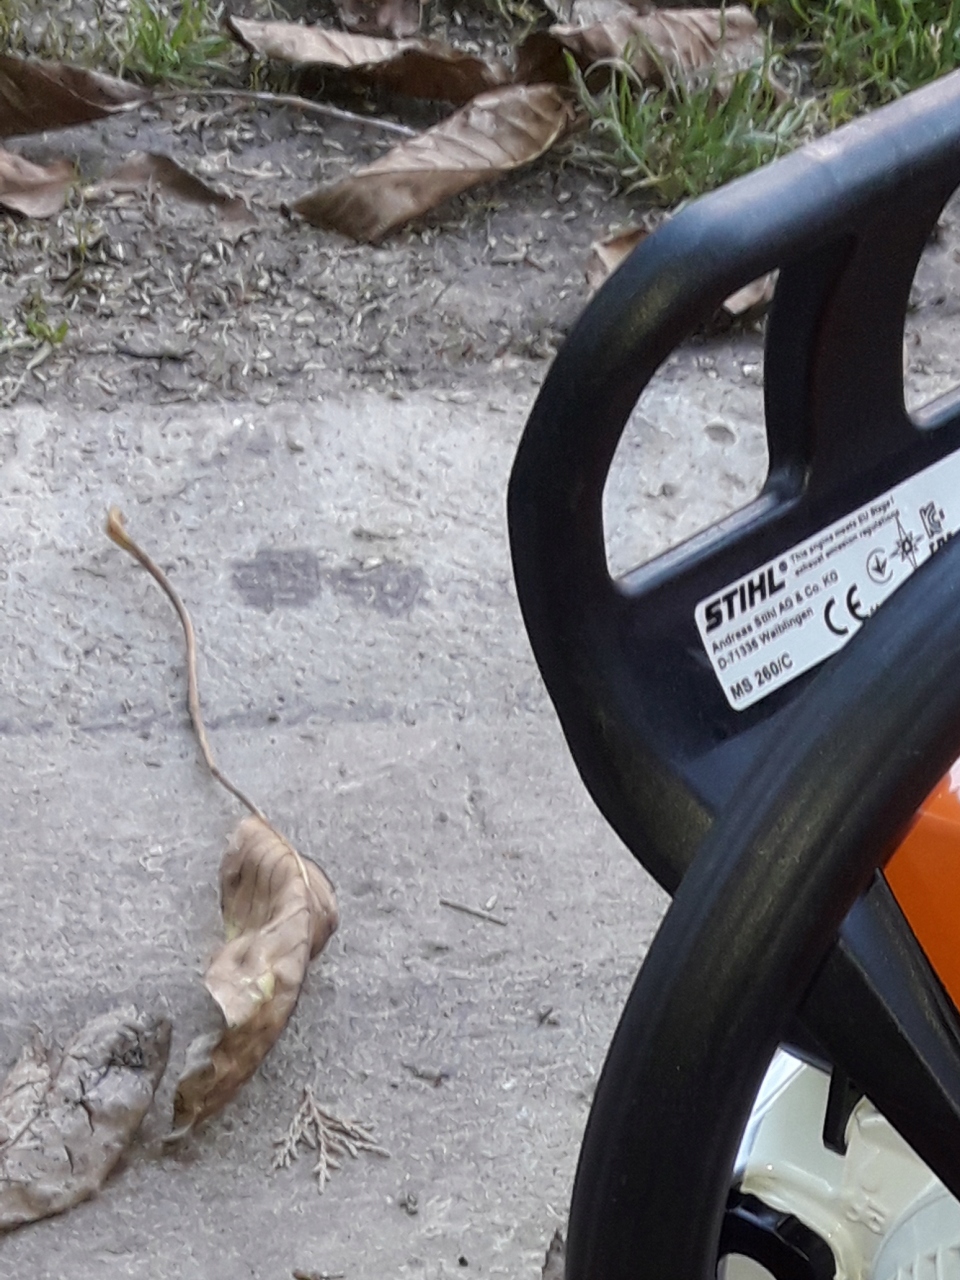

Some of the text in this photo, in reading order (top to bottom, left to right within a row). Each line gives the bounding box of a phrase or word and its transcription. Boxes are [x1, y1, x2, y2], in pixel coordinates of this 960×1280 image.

[711, 624, 753, 654] Andreas
[753, 607, 778, 628] Stihl
[717, 607, 815, 671] D-71336 Waiblingen
[730, 652, 794, 700] MS 260/C
